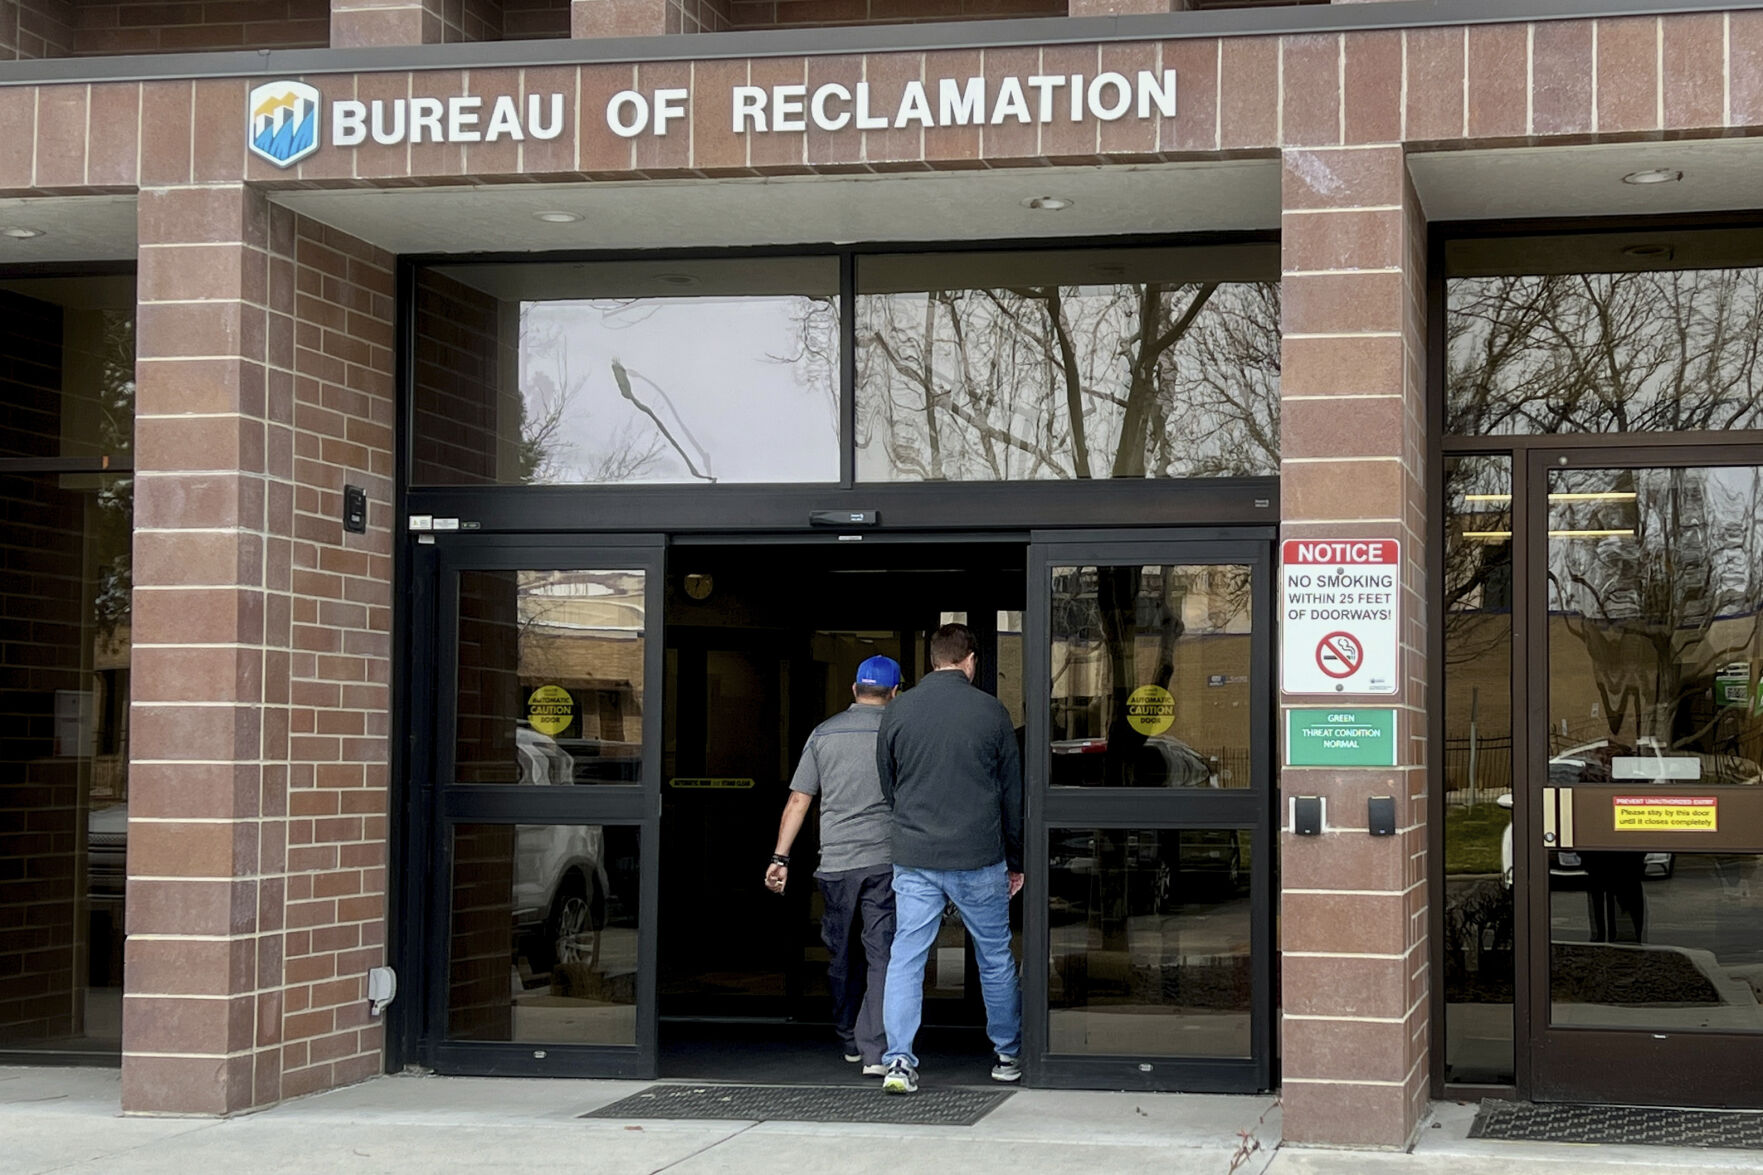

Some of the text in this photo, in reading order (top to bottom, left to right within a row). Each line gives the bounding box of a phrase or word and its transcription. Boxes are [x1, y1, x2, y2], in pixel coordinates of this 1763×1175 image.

[332, 69, 1177, 146] BUREAU OF RECLAMATION
[1298, 543, 1383, 562] NOTICE
[1288, 575, 1392, 588] NO SMOKING
[1289, 593, 1392, 604] WITHIN 25 FEET
[1288, 609, 1391, 620] OF DOORWAYS!
[530, 705, 571, 714] CAUTION
[1129, 705, 1173, 715] CAUTION
[1327, 714, 1355, 722] GREEN
[1302, 728, 1380, 737] THREAT CONDITION
[1323, 740, 1359, 748] NORMAL
[1665, 809, 1673, 817] by
[1670, 819, 1712, 827] completely
